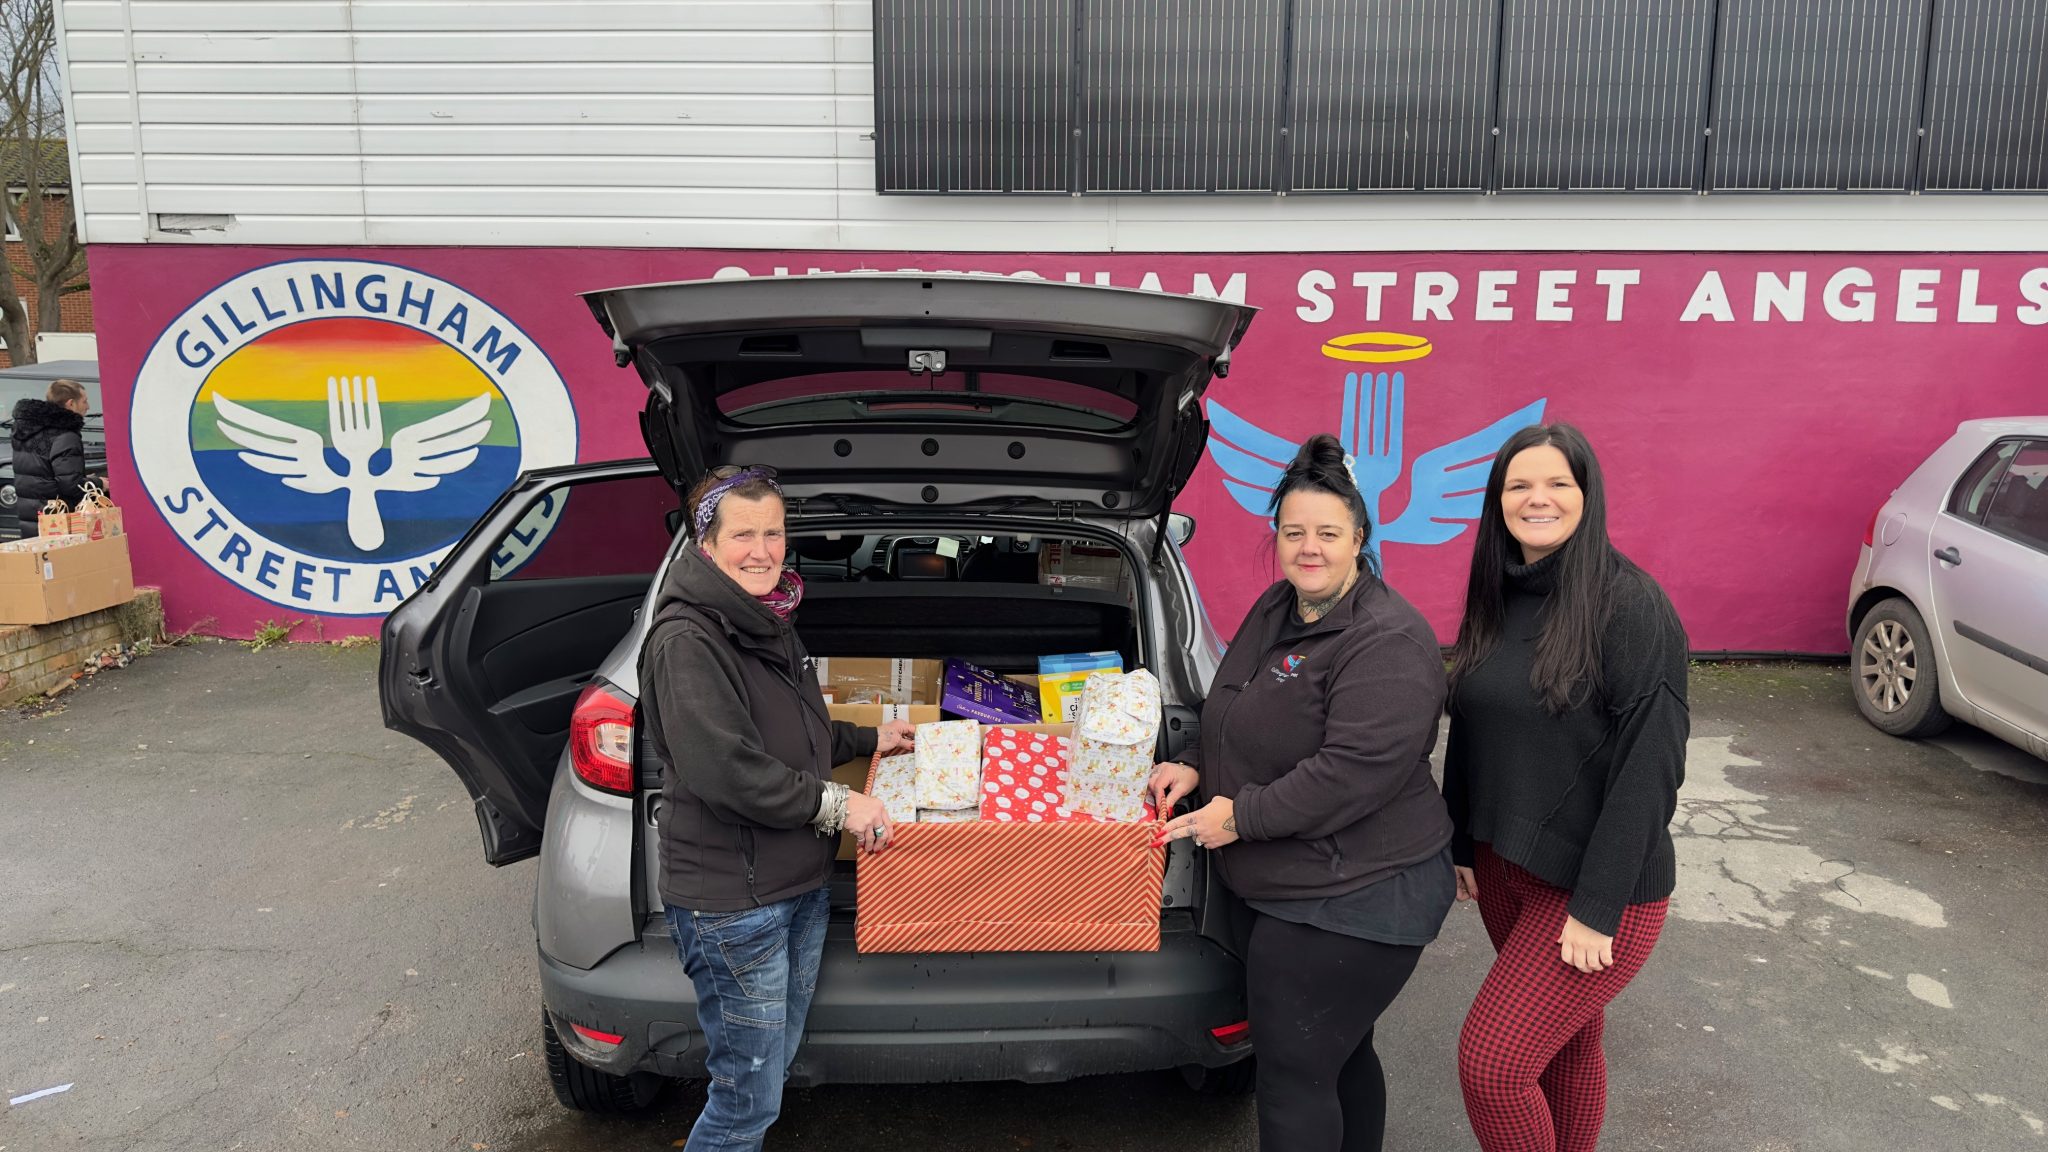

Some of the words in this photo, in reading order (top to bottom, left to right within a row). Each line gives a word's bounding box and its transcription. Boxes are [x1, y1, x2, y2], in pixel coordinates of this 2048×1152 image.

[175, 272, 522, 376] GILLINGHAM
[1296, 269, 1640, 323] STREET
[1680, 266, 2048, 324] ANGELS
[164, 486, 351, 604] STREET
